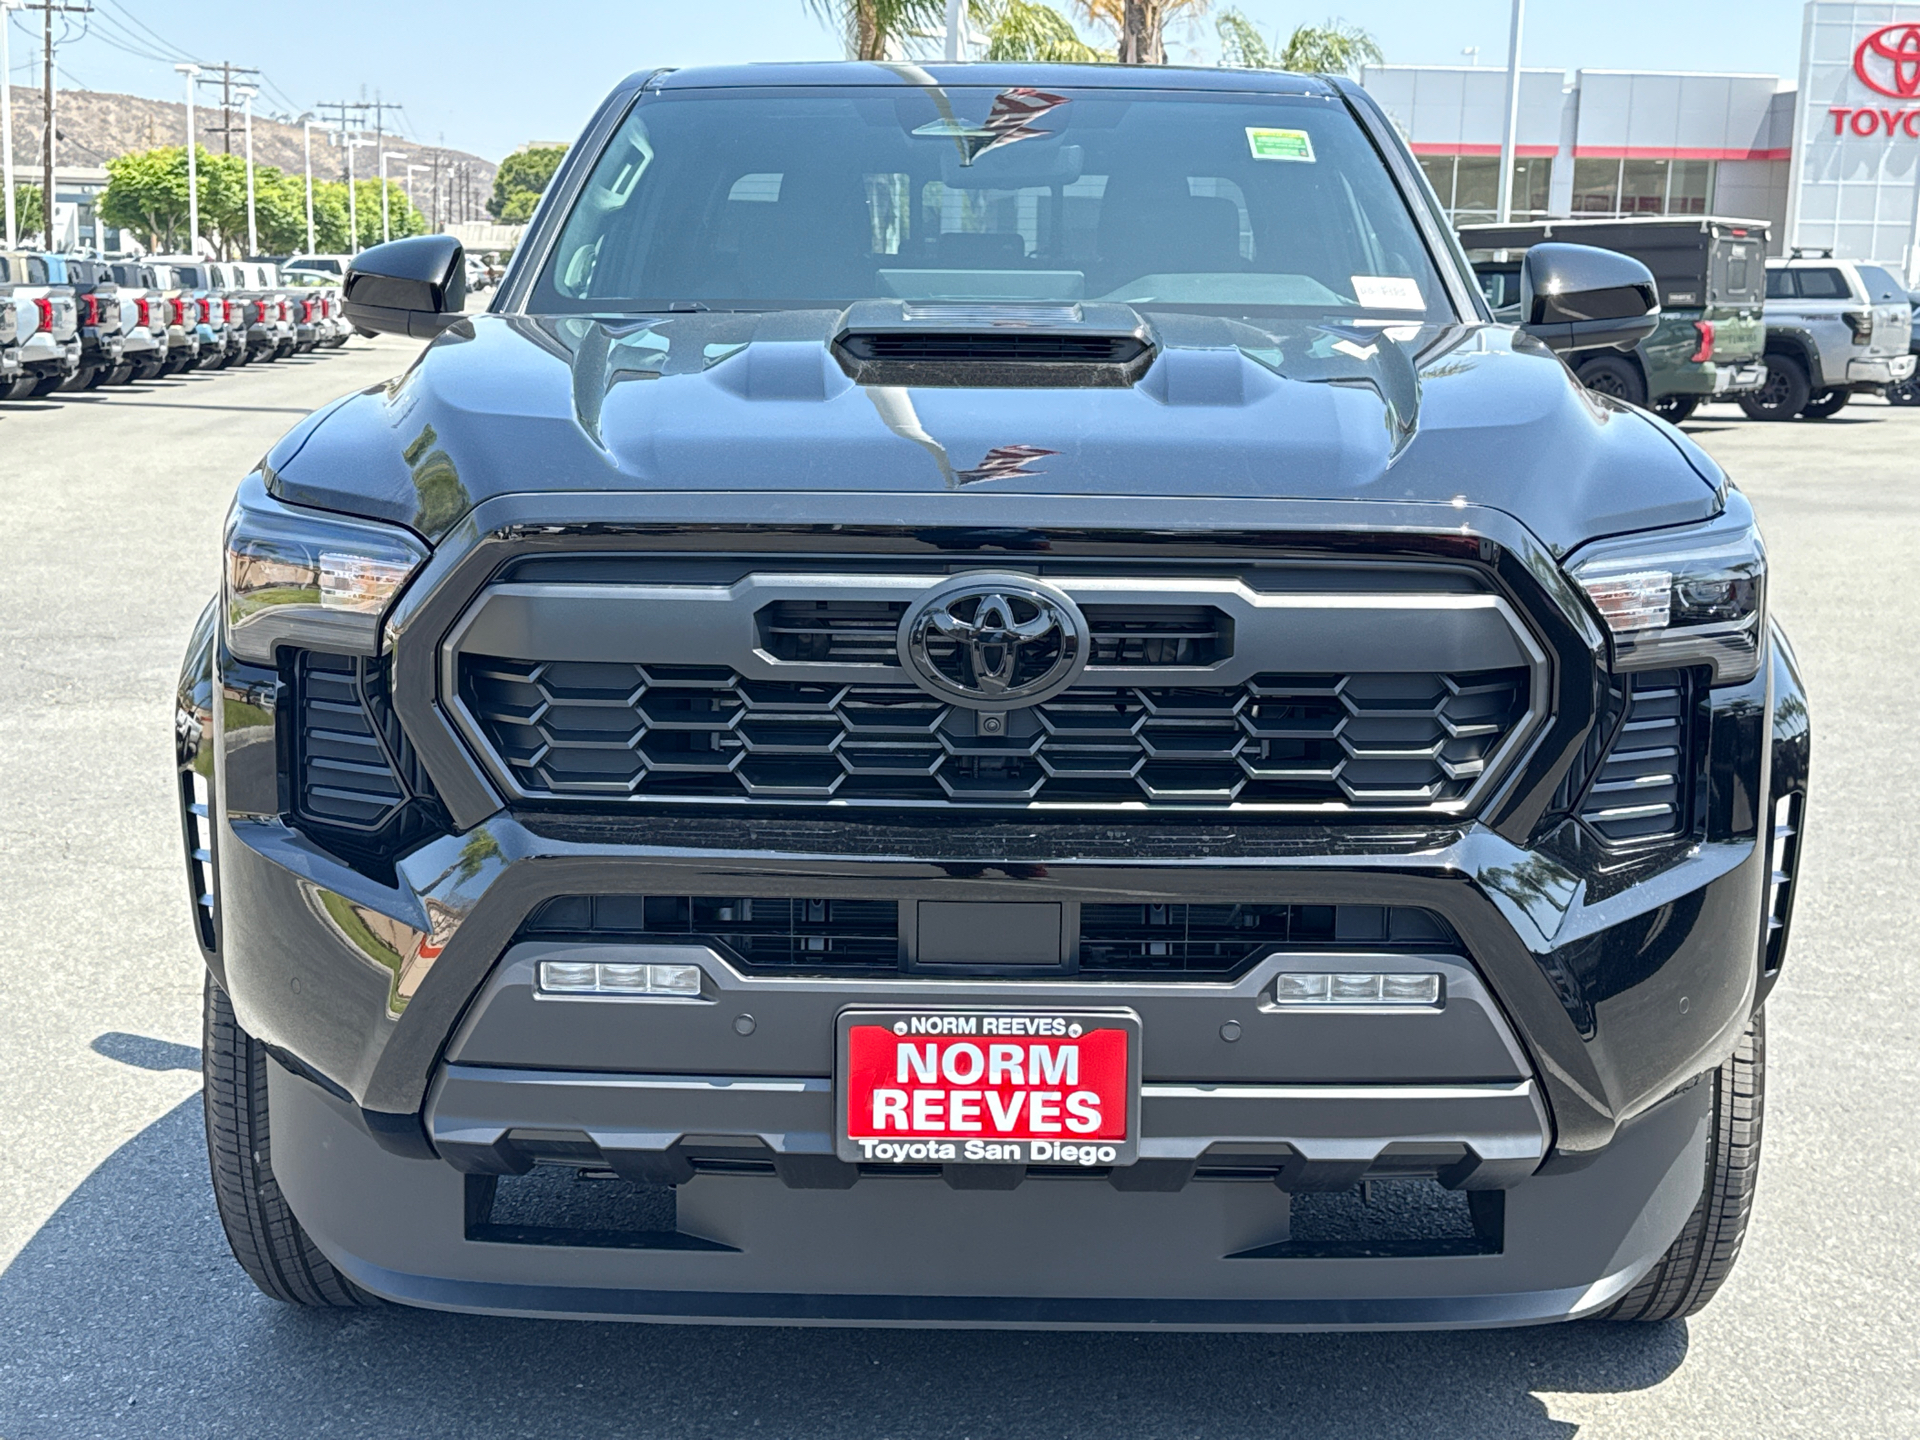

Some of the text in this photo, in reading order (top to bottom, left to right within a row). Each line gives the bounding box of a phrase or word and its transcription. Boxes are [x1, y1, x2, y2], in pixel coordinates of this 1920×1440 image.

[911, 1017, 1066, 1036] NORM REEVES
[897, 1042, 1079, 1086] NORM
[872, 1089, 1102, 1133] REEVES
[858, 1140, 1116, 1165] Toyota San Diego
